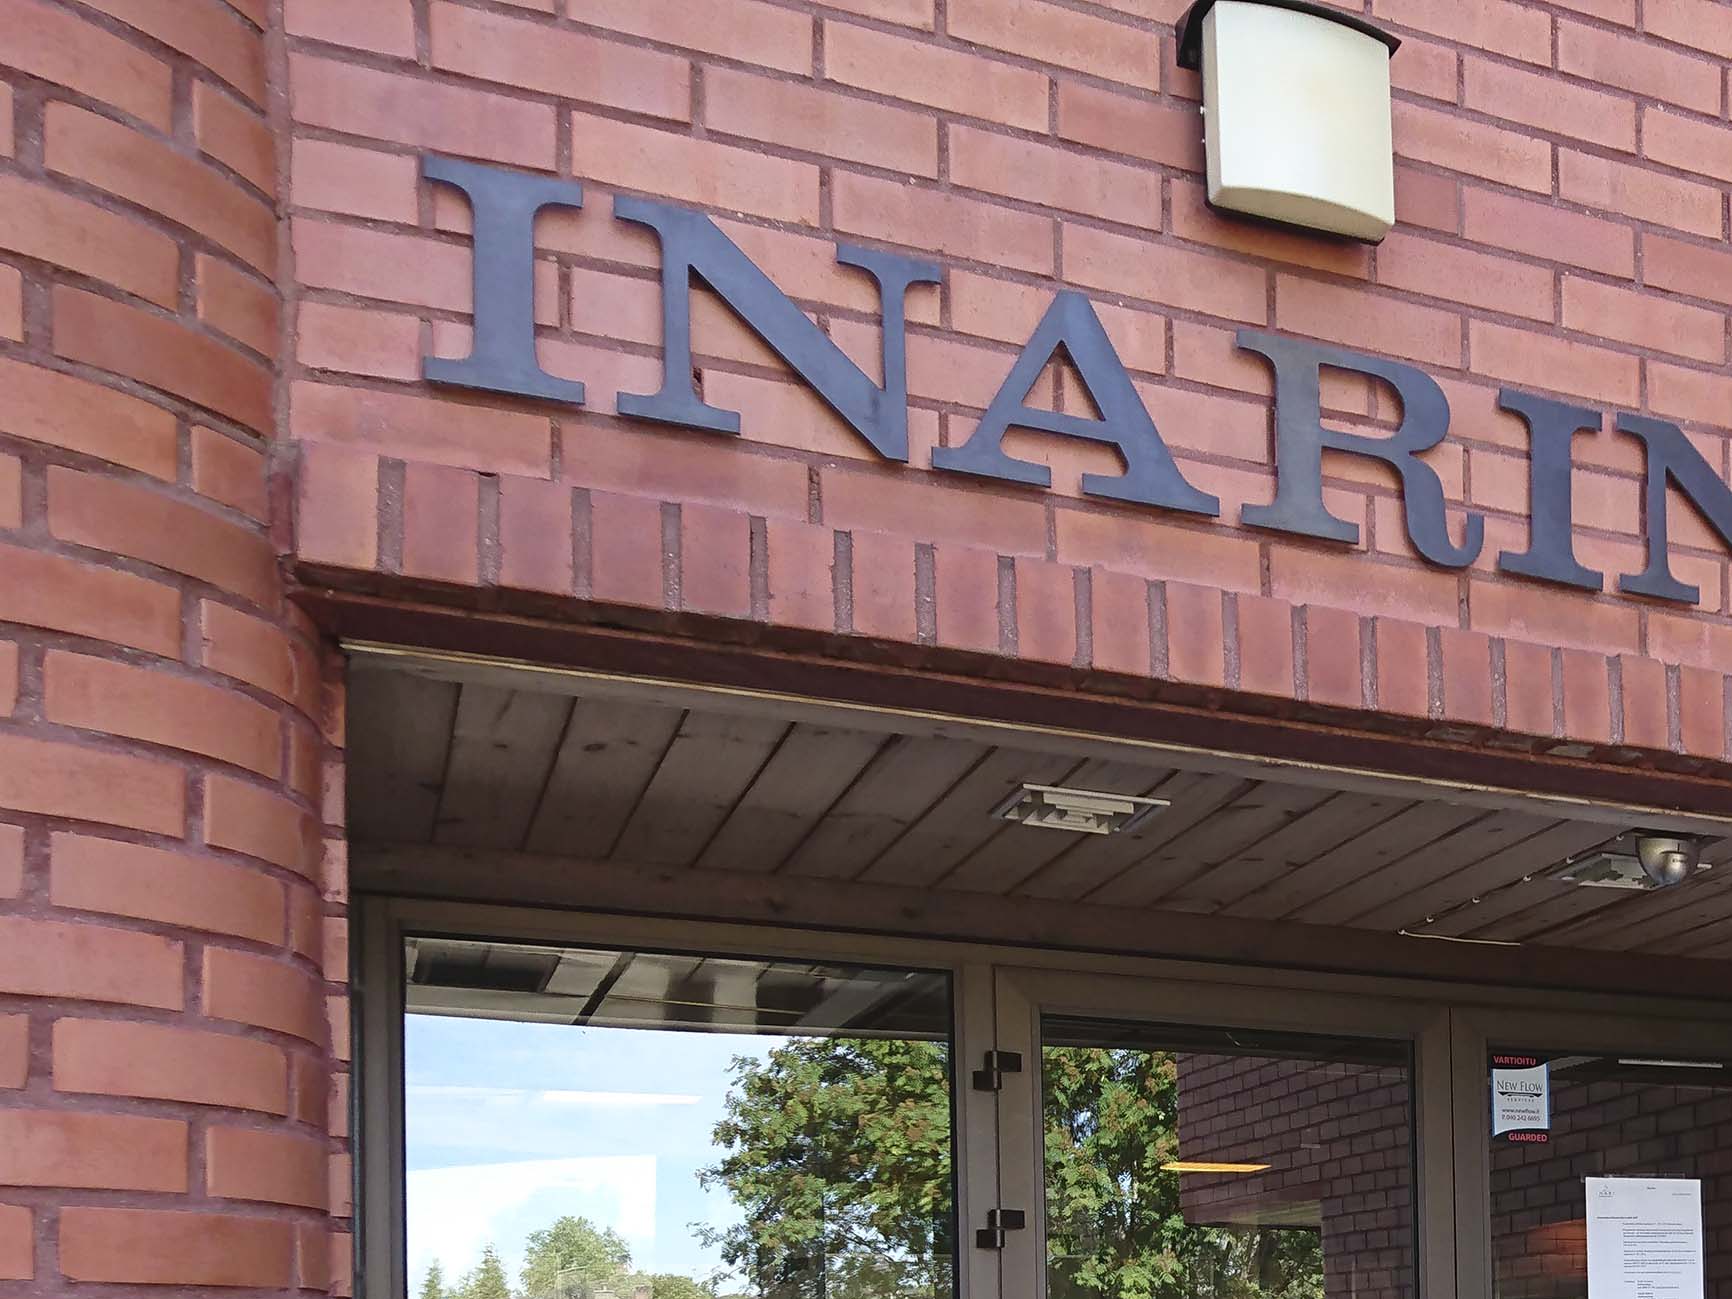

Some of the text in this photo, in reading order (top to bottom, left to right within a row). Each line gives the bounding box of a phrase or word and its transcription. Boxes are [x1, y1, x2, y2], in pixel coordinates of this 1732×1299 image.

[1493, 1055, 1536, 1066] VARTIOITU
[1496, 1080, 1543, 1092] NEW FLOW
[1508, 1132, 1548, 1142] GUARDED
